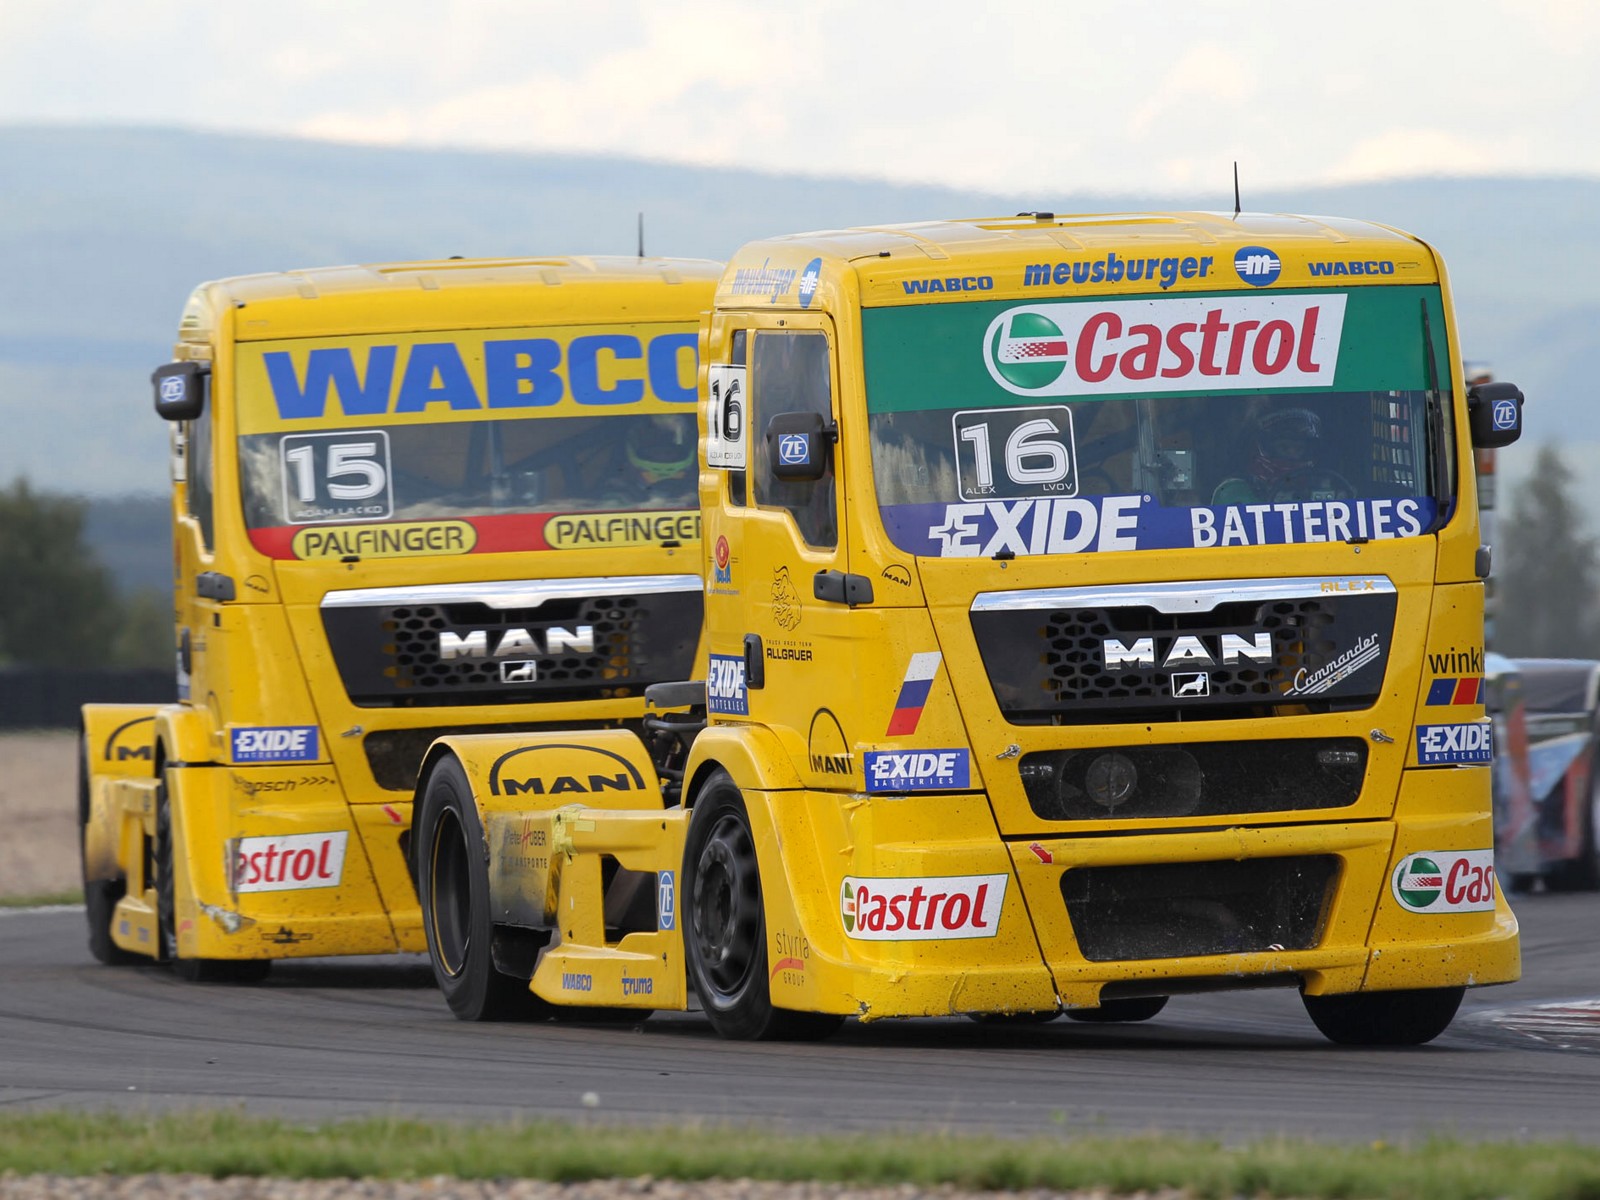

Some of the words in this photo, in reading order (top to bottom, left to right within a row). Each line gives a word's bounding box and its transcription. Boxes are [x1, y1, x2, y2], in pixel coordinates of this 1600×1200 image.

[1023, 253, 1213, 287] meusburger
[1308, 260, 1394, 276] WABCO
[903, 276, 993, 294] WABCO
[1075, 306, 1320, 383] Castrol
[262, 333, 699, 420] WABCO
[712, 379, 742, 442] 16
[1494, 403, 1516, 426] ZF
[782, 439, 805, 459] ZF
[961, 418, 1069, 487] 16
[286, 442, 386, 502] 15
[965, 486, 996, 495] ALEX
[1043, 482, 1073, 491] LVOV
[928, 495, 1142, 557] EXIDE
[1190, 499, 1422, 548] BATTERIES
[304, 526, 464, 557] PALFINGER
[884, 572, 909, 586] MAN
[1320, 580, 1376, 592] ALEX
[440, 625, 594, 659] MAN
[1103, 633, 1273, 671] MAN
[1293, 632, 1378, 692] Commander
[1428, 647, 1485, 674] winkl
[709, 659, 745, 699] EXIDE
[234, 729, 308, 752] EXIDE
[1420, 725, 1490, 752] EXIDE
[871, 753, 957, 779] EXIDE
[502, 773, 631, 796] MAN
[874, 777, 954, 787] BATTERIES
[856, 884, 988, 932] Castrol
[562, 973, 592, 991] WABCO
[621, 976, 653, 995] truma
[783, 971, 805, 987] GROUP
